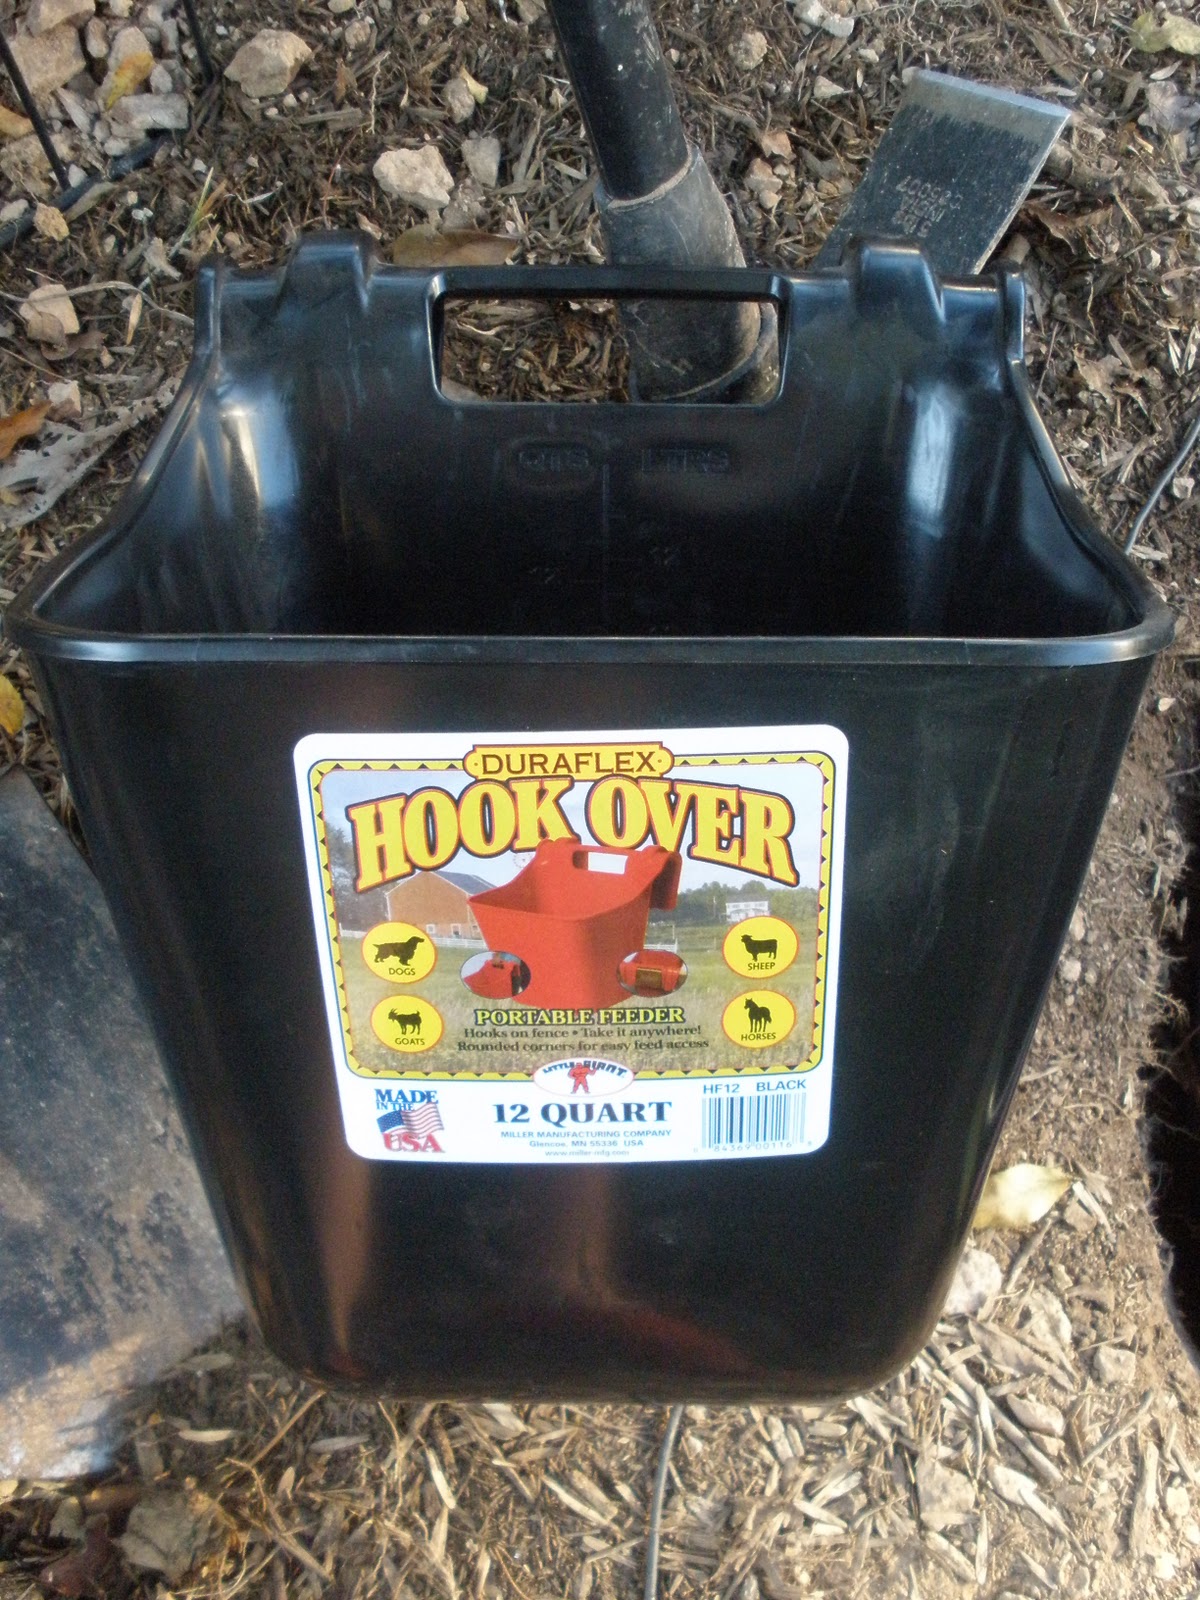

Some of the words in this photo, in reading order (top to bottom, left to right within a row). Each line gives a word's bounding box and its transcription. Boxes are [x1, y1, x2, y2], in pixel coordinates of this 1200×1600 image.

[481, 751, 656, 775] DURAFLEX
[346, 776, 581, 893] HOOK
[584, 774, 800, 887] OVER
[388, 967, 416, 976] DOGS
[747, 962, 776, 971] SHEEP
[475, 1009, 593, 1026] PORTABLE
[598, 1008, 684, 1024] FEEDER
[464, 1028, 508, 1039] Hooks
[511, 1030, 530, 1038] on
[532, 1028, 569, 1038] fence
[580, 1028, 614, 1037] Take
[616, 1027, 626, 1037] it
[629, 1025, 702, 1039] anywhere!
[741, 1032, 776, 1041] HORSES
[395, 1037, 425, 1046] GOATS
[457, 1041, 519, 1052] Rounded
[522, 1042, 574, 1051] corners
[578, 1041, 599, 1051] for
[601, 1041, 631, 1053] easy
[633, 1039, 663, 1050] feed
[665, 1040, 709, 1049] access
[543, 1062, 575, 1074] LITTLE
[703, 1084, 740, 1094] HF12
[756, 1079, 807, 1092] BLACK
[374, 1088, 439, 1104] MADE
[376, 1101, 388, 1110] IN
[391, 1102, 415, 1111] THE
[493, 1103, 530, 1123] 12
[540, 1102, 672, 1128] QUART
[382, 1131, 446, 1153] USA
[624, 1139, 644, 1147] USA
